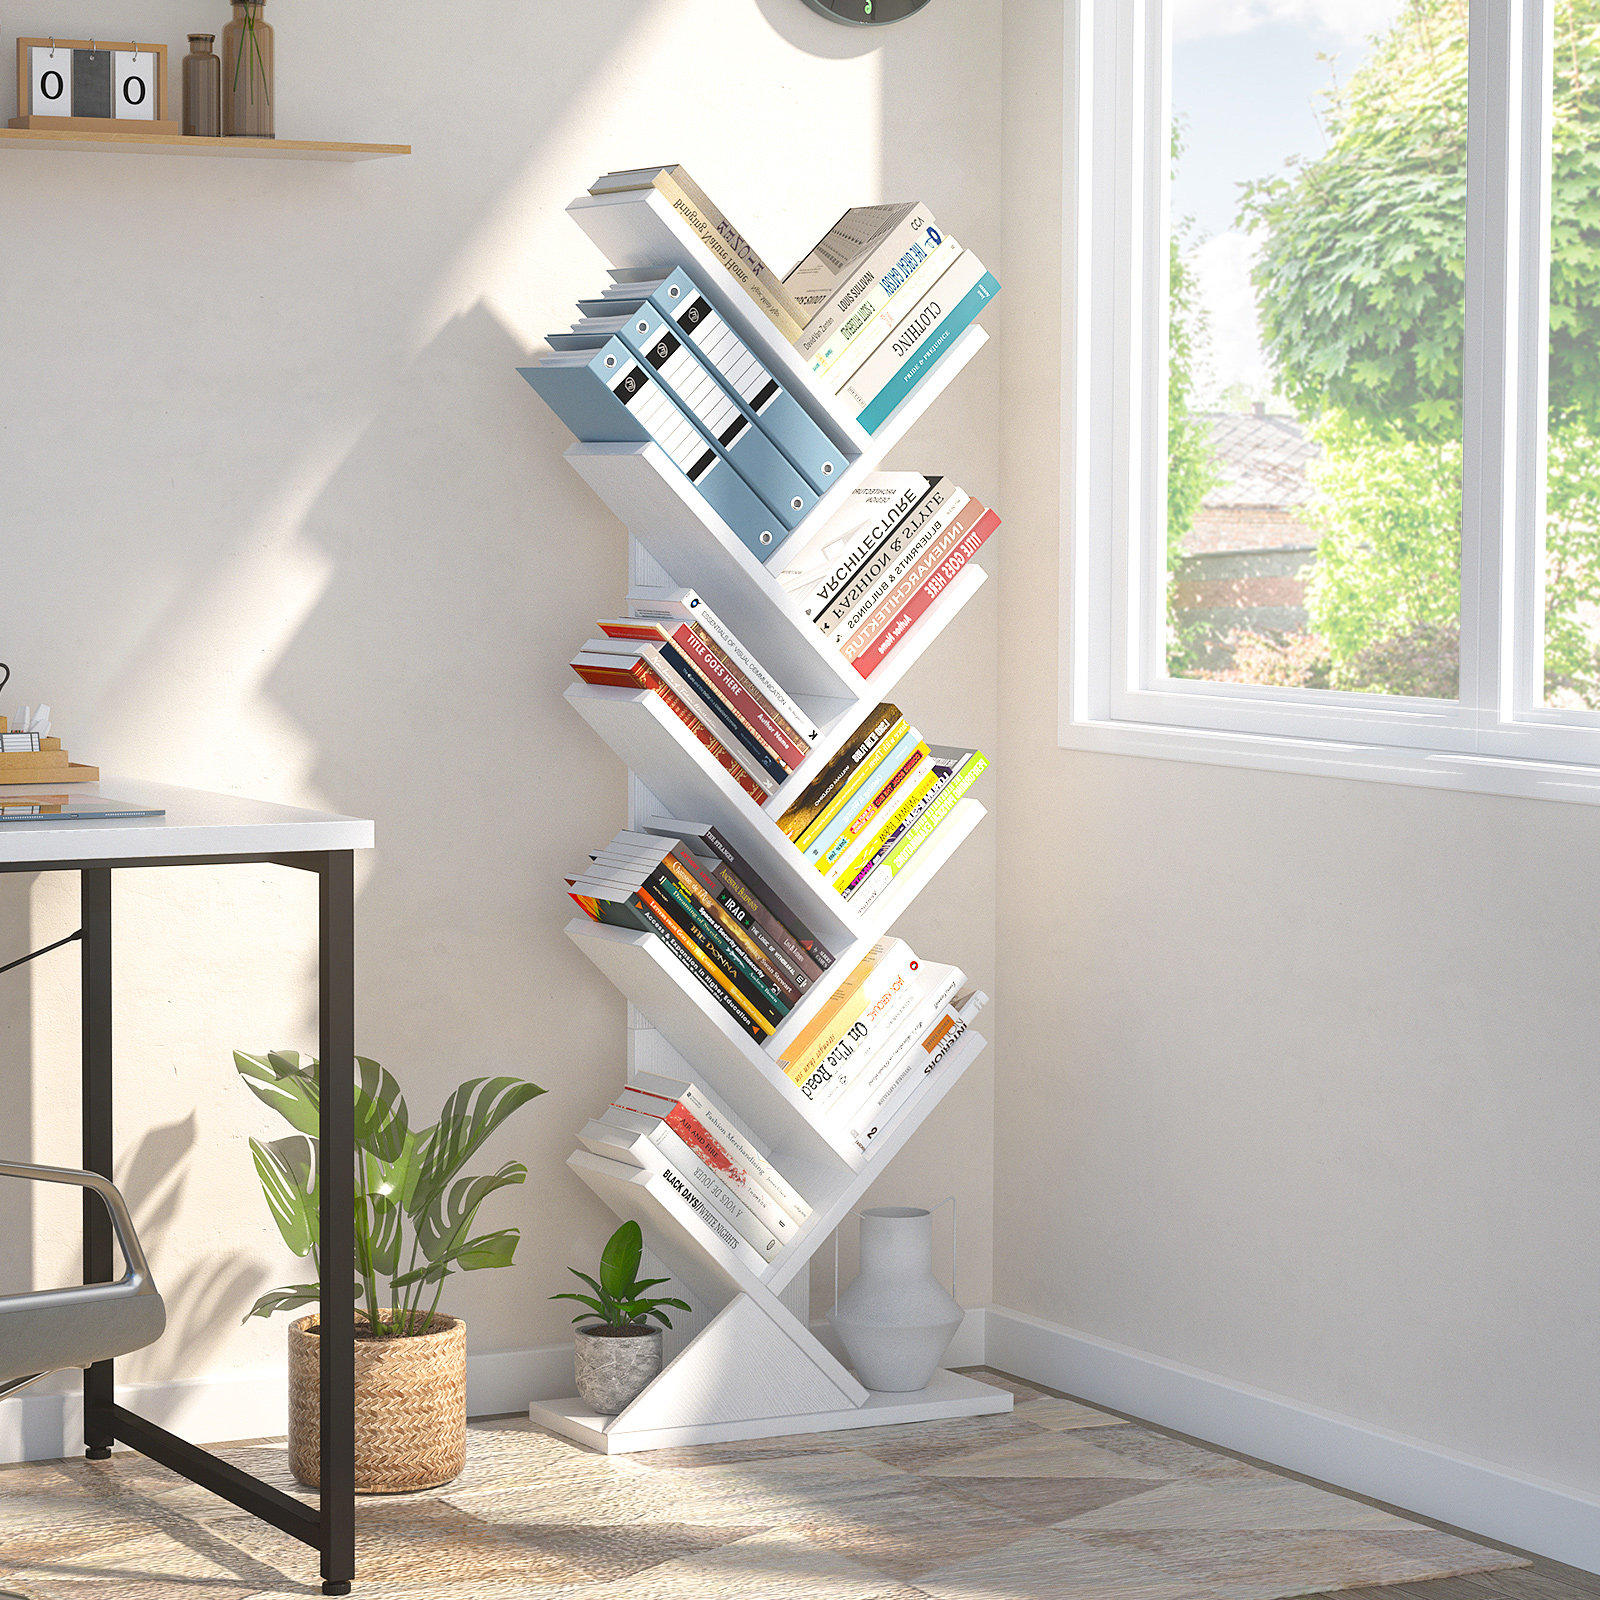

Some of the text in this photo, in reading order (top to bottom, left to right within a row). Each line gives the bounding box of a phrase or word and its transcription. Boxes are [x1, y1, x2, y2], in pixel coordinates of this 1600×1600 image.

[909, 213, 924, 232] CCA
[878, 239, 927, 297] THE GREAT GATSBY
[837, 269, 874, 313] LOUIS SULLIVAN
[891, 299, 942, 358] CLOTHING
[903, 363, 920, 382] PRIDE
[922, 329, 950, 361] PREJUDICE
[685, 633, 706, 656] TITLE
[702, 652, 725, 678] GOES
[721, 674, 743, 697] HERE
[726, 638, 736, 649] OF
[732, 646, 750, 665] VISUAL
[756, 712, 791, 750] Author Name
[722, 897, 747, 922] IRAQ
[749, 925, 760, 936] THE
[687, 922, 708, 944] THE
[704, 941, 740, 979] DONNA
[697, 906, 716, 925] Spaces
[716, 927, 738, 949] Security
[734, 945, 745, 957] and
[741, 953, 765, 979] Insecurity
[643, 910, 666, 934] Access
[668, 937, 699, 971] Expansion
[702, 974, 724, 997] Higher
[722, 994, 751, 1025] Education
[759, 957, 775, 974] Swan
[772, 971, 793, 993] Stewart
[800, 1019, 869, 1101] On The Road
[923, 1022, 967, 1076] INTERIORS
[679, 1116, 719, 1159] AIR AND FIRE
[704, 1110, 726, 1134] Fashion
[724, 1132, 766, 1176] Merchandising
[661, 1168, 684, 1193] BLACK
[692, 1164, 715, 1189] JOUER
[710, 1183, 722, 1198] DE
[719, 1192, 737, 1213] VOUS
